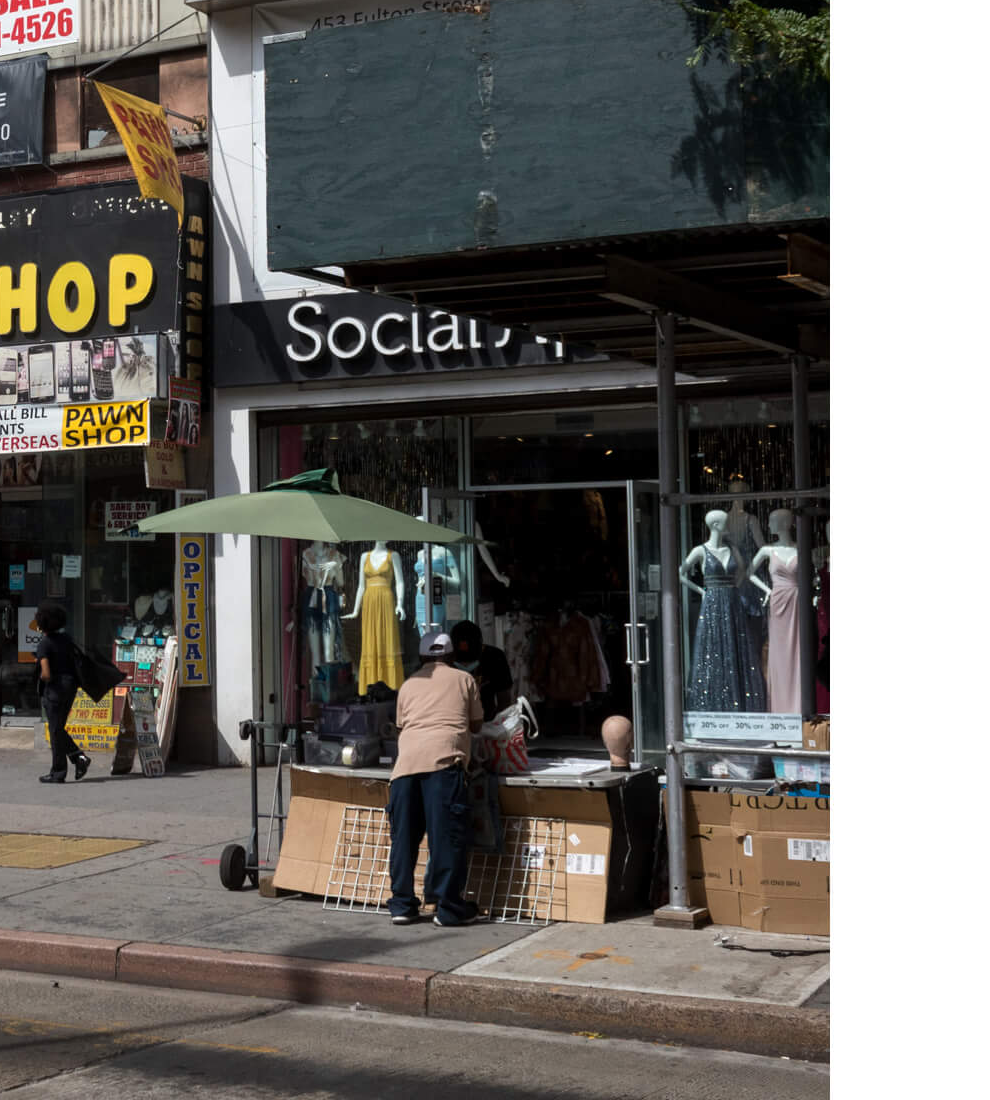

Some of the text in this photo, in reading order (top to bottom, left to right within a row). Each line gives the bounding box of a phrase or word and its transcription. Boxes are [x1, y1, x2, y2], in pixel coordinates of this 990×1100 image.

[21, 407, 47, 419] BILL
[65, 404, 145, 428] PAWN
[65, 425, 145, 447] SHOP
[183, 542, 202, 680] OPTICAL
